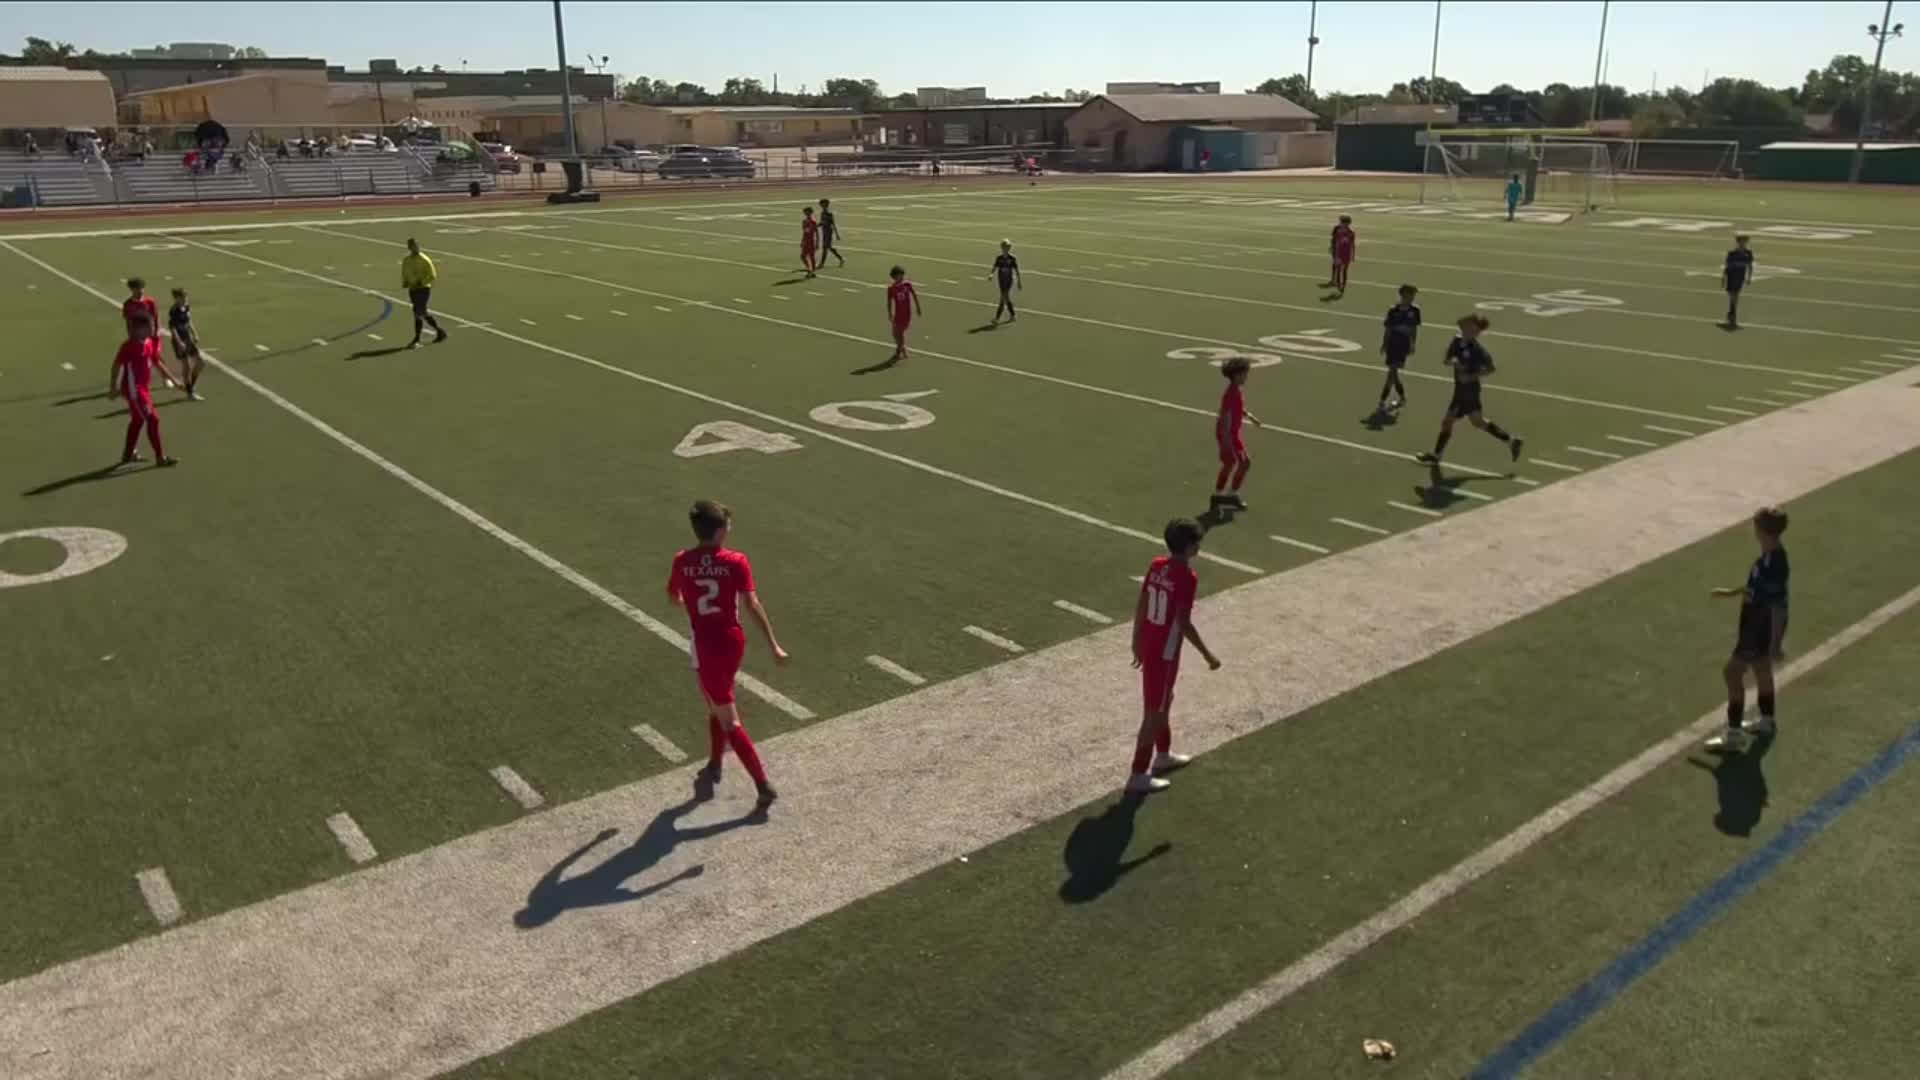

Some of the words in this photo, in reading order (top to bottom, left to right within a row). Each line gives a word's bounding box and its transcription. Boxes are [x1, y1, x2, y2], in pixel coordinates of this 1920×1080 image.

[1166, 334, 1363, 369] 30
[672, 400, 937, 459] 40
[683, 565, 731, 577] TEXANS
[695, 578, 722, 616] 2
